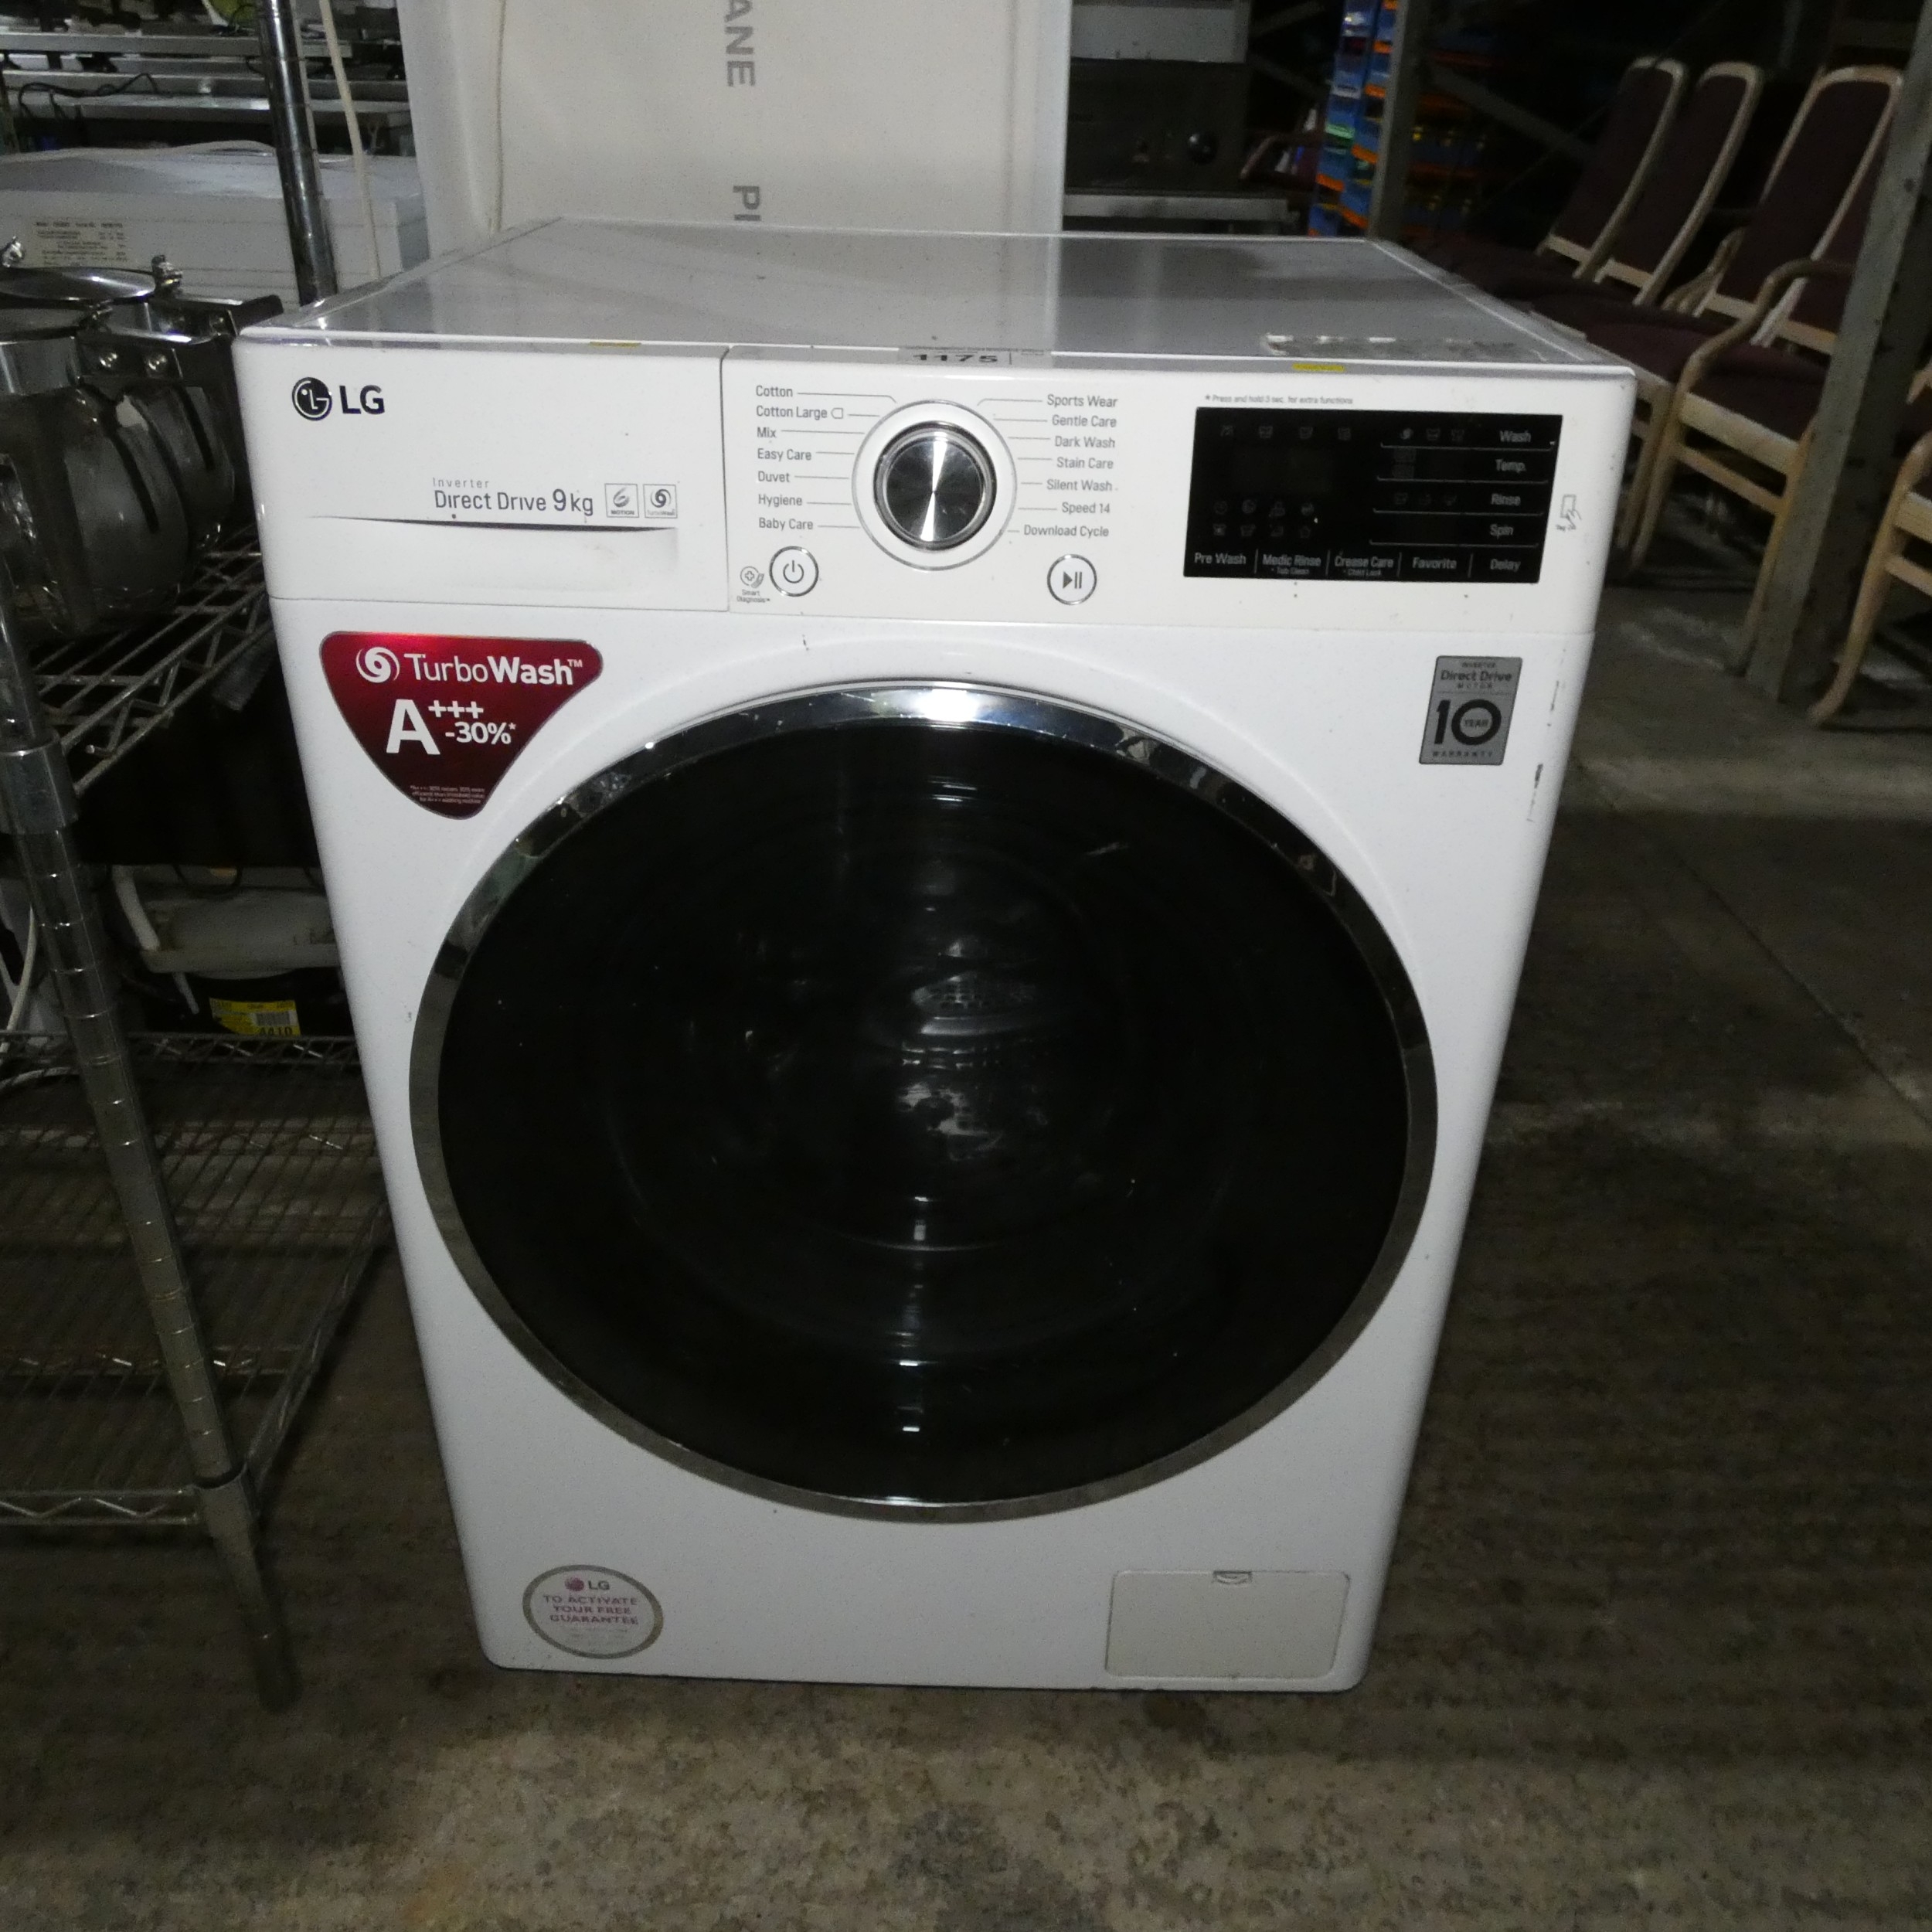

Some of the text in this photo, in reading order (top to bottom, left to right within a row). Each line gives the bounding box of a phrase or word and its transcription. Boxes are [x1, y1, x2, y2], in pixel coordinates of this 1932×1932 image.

[913, 353, 998, 362] 1175
[756, 385, 794, 397] Cotton
[338, 385, 385, 415] LG
[1046, 393, 1118, 408] Sports Wear
[756, 405, 828, 420] Cotton Large
[1052, 414, 1117, 427] Gentle Care
[757, 427, 777, 438] Mix
[1499, 430, 1532, 443] Wash
[1054, 435, 1115, 448] Dark Wash
[757, 447, 812, 462] Easy Care
[1056, 457, 1114, 469] Stain Care
[432, 477, 489, 488] Inverter
[757, 471, 790, 483] Duvet
[1046, 478, 1113, 492] Silent Wash
[434, 489, 492, 510] Direct
[497, 492, 547, 512] Drive
[758, 494, 803, 508] Hygiene
[1491, 493, 1521, 505] Rinse
[1061, 502, 1111, 515] Speed 14
[758, 517, 814, 531] Baby Care
[1023, 524, 1110, 539] Download Cycle
[1490, 524, 1514, 539] Spin
[1194, 552, 1247, 564] Pre Wash
[1262, 553, 1321, 566] Medic Rinse
[1370, 556, 1394, 568] Care
[1412, 556, 1458, 569] Favorite
[1490, 558, 1522, 571] Delay
[1440, 669, 1512, 682] Direct Drive
[1434, 699, 1502, 746] 10
[587, 1580, 610, 1590] LG
[543, 1594, 638, 1606] TO ACTIVATE
[553, 1605, 593, 1614] YOUR
[549, 1614, 638, 1625] GUARANTEE
